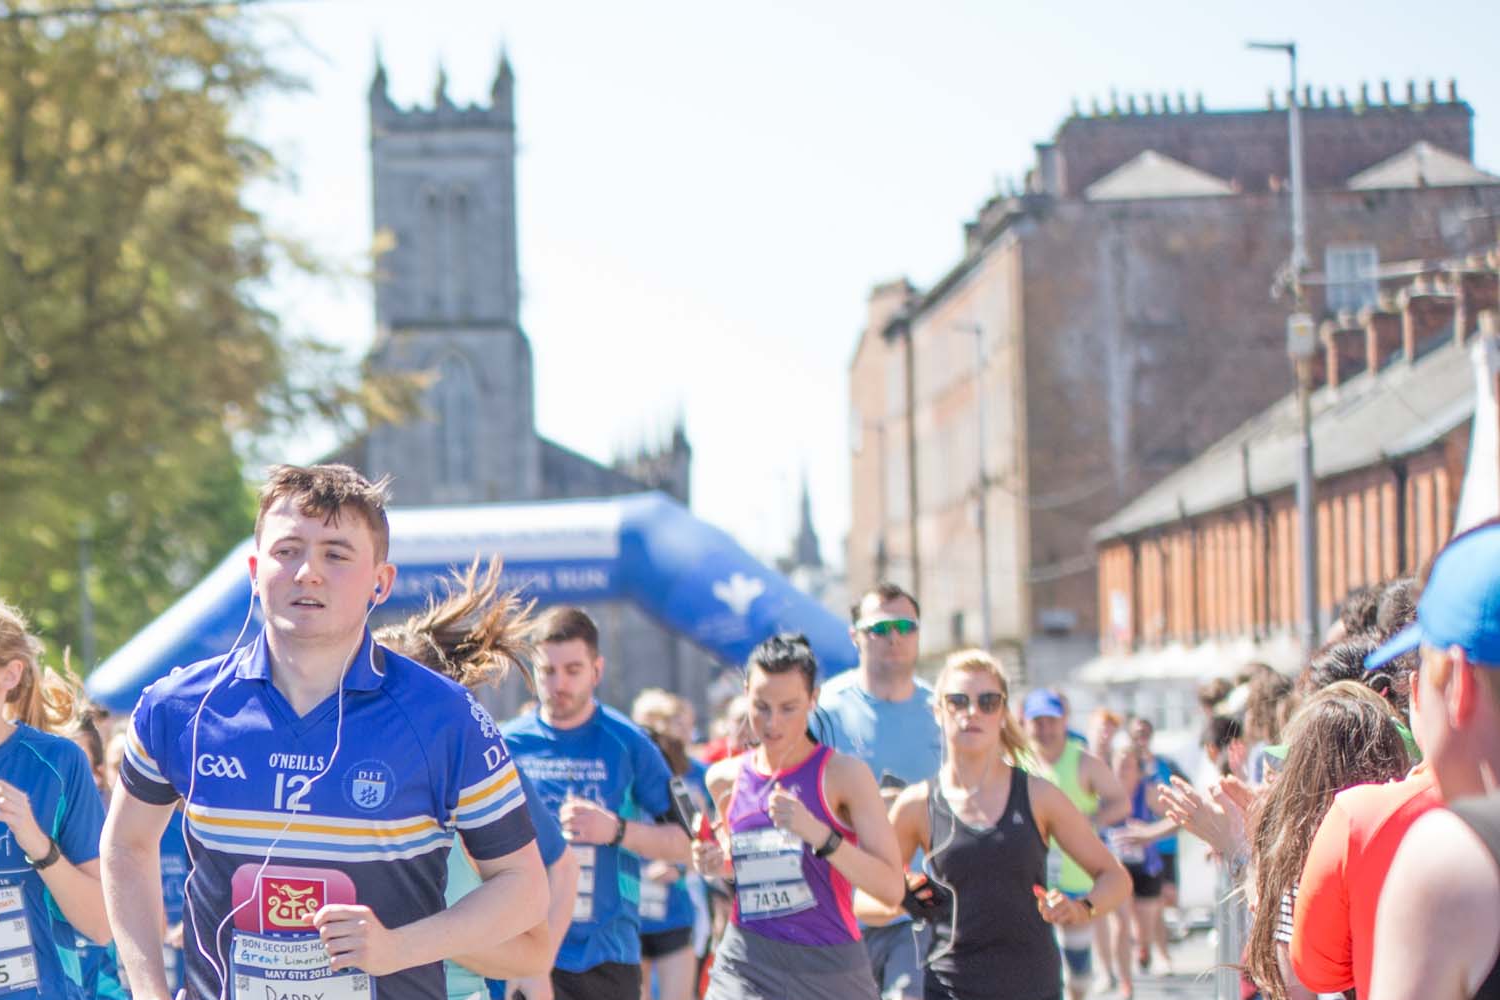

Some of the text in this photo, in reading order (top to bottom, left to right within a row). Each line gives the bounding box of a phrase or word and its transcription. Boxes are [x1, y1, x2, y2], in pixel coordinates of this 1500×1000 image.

[269, 752, 325, 772] O'NEILLS
[273, 774, 312, 812] 12
[242, 938, 260, 949] BON
[263, 942, 308, 953] SECOURS
[241, 949, 280, 965] Great
[264, 969, 287, 980] MAY
[288, 970, 308, 980] 6TH
